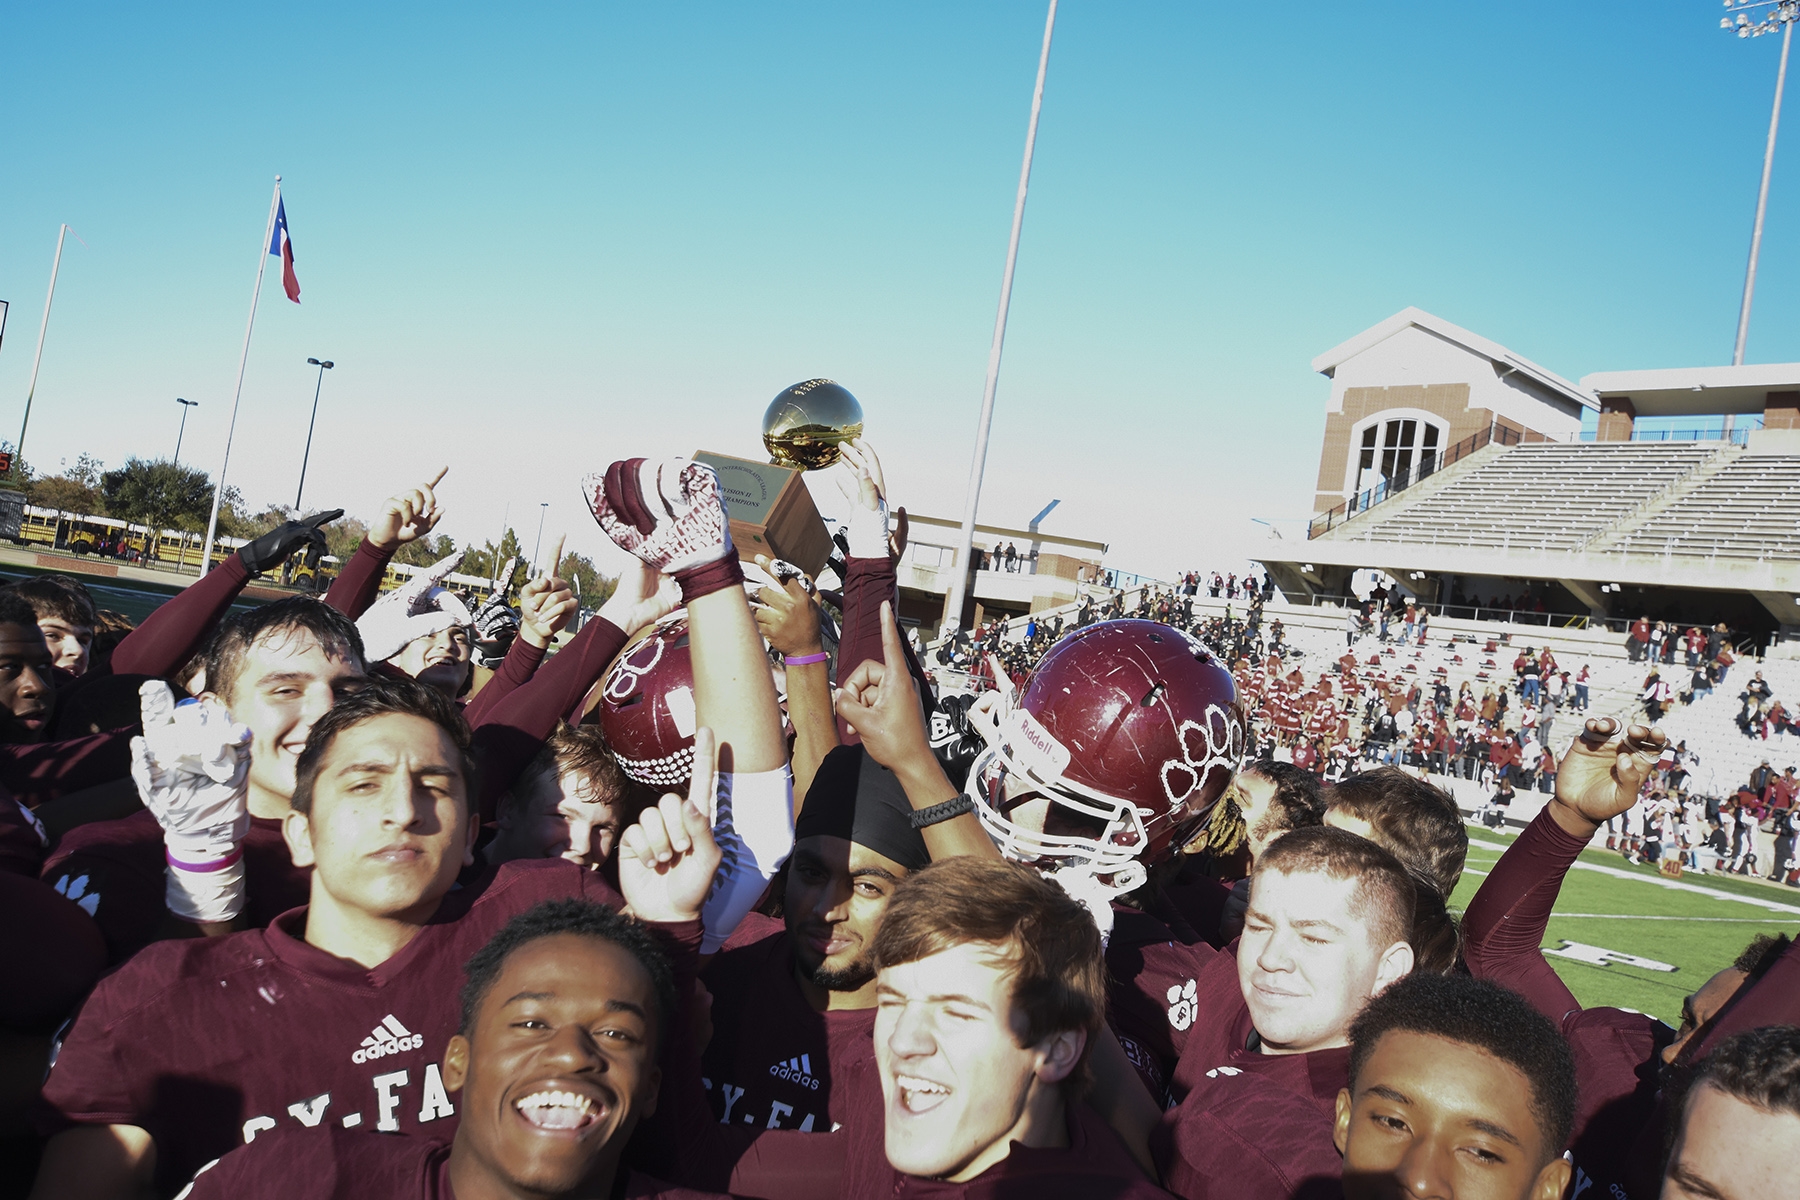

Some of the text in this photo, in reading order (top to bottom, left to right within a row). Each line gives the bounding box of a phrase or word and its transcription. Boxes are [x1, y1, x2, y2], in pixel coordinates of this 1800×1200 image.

[1020, 719, 1053, 755] Riddell
[1663, 861, 1681, 875] 40
[352, 1033, 424, 1064] adidas
[769, 1064, 820, 1091] adidas
